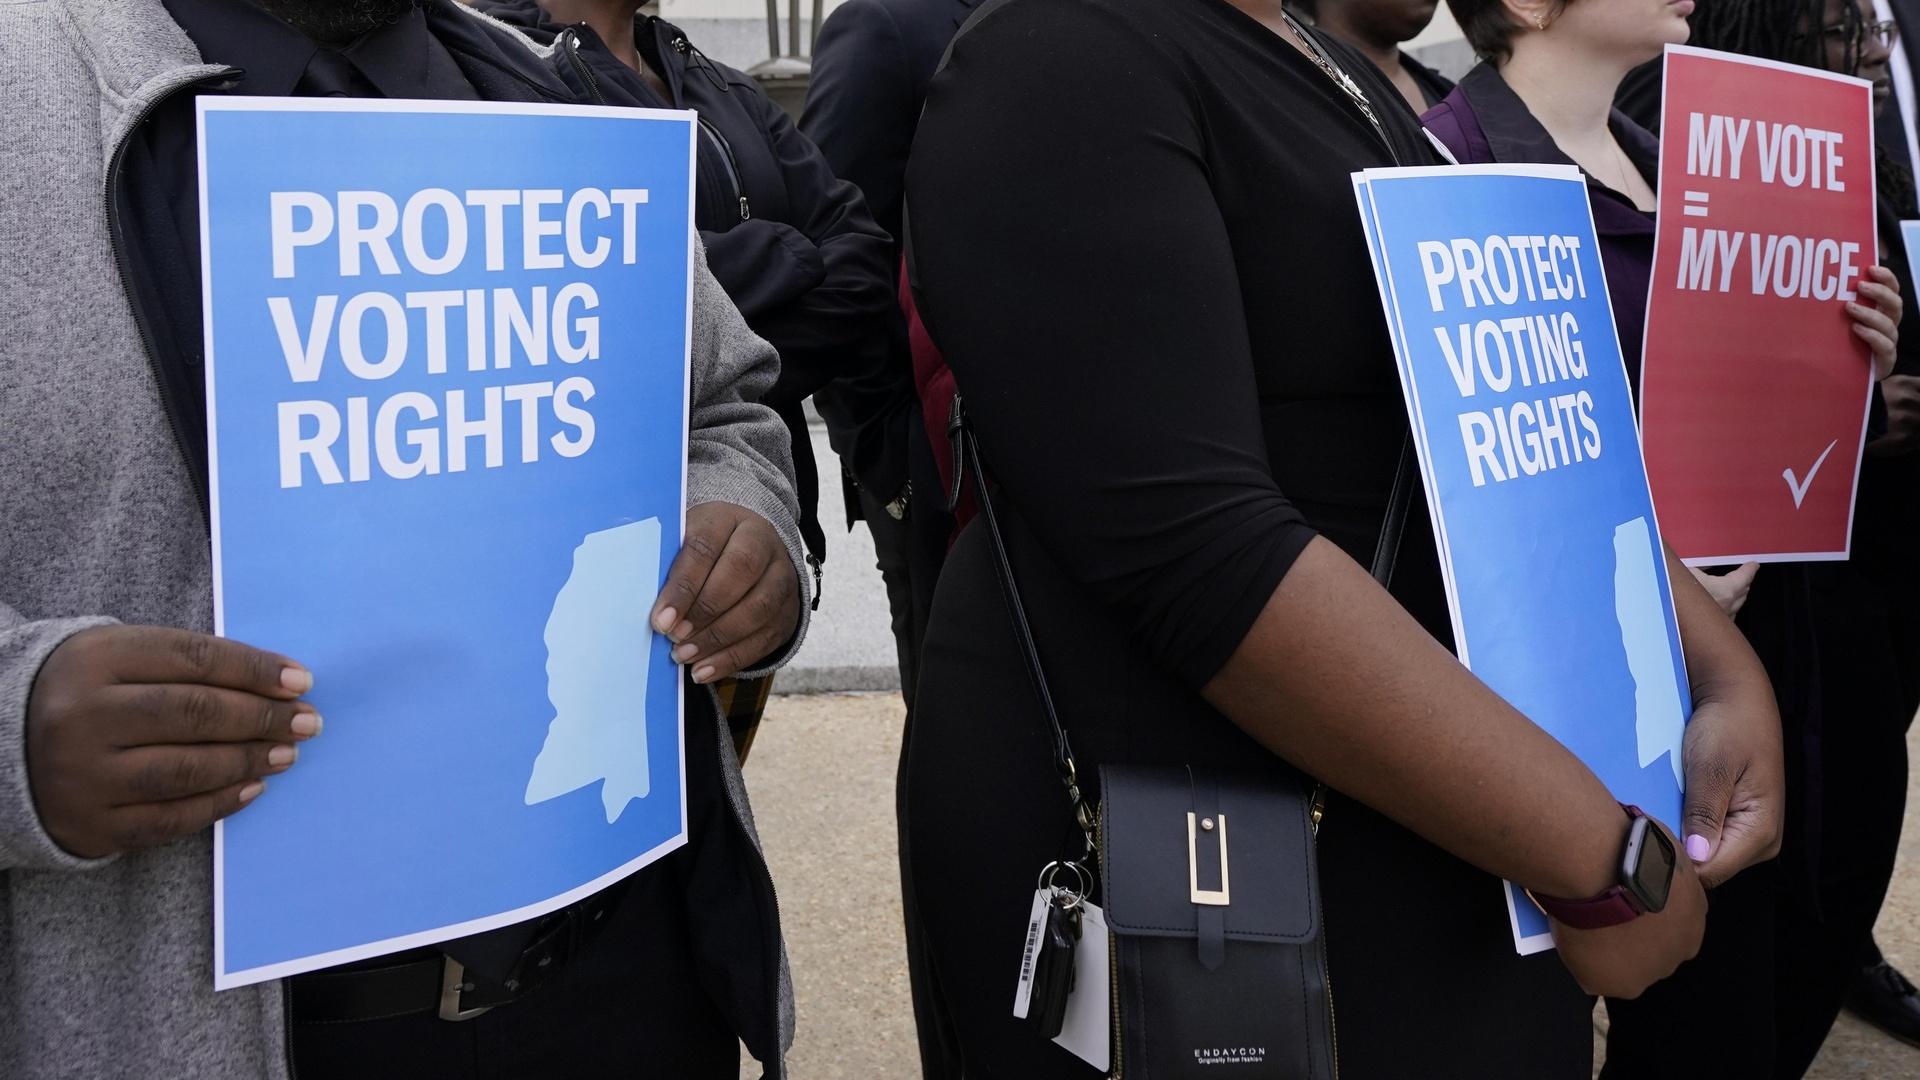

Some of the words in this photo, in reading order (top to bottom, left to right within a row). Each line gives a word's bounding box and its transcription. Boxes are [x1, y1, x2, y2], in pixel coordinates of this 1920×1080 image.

[1687, 111, 1751, 180] MY
[1756, 120, 1845, 192] VOTE
[269, 187, 649, 279] PROTECT
[1683, 190, 1709, 217] =
[1416, 234, 1587, 313] PROTECT
[1676, 227, 1745, 293] MY
[1750, 233, 1860, 301] VOICE
[266, 281, 600, 383] VOTING
[1433, 311, 1589, 398] VOTING
[278, 376, 596, 489] RIGHTS
[1457, 390, 1602, 488] RIGHTS
[1194, 1047, 1266, 1058] ENDAYCON
